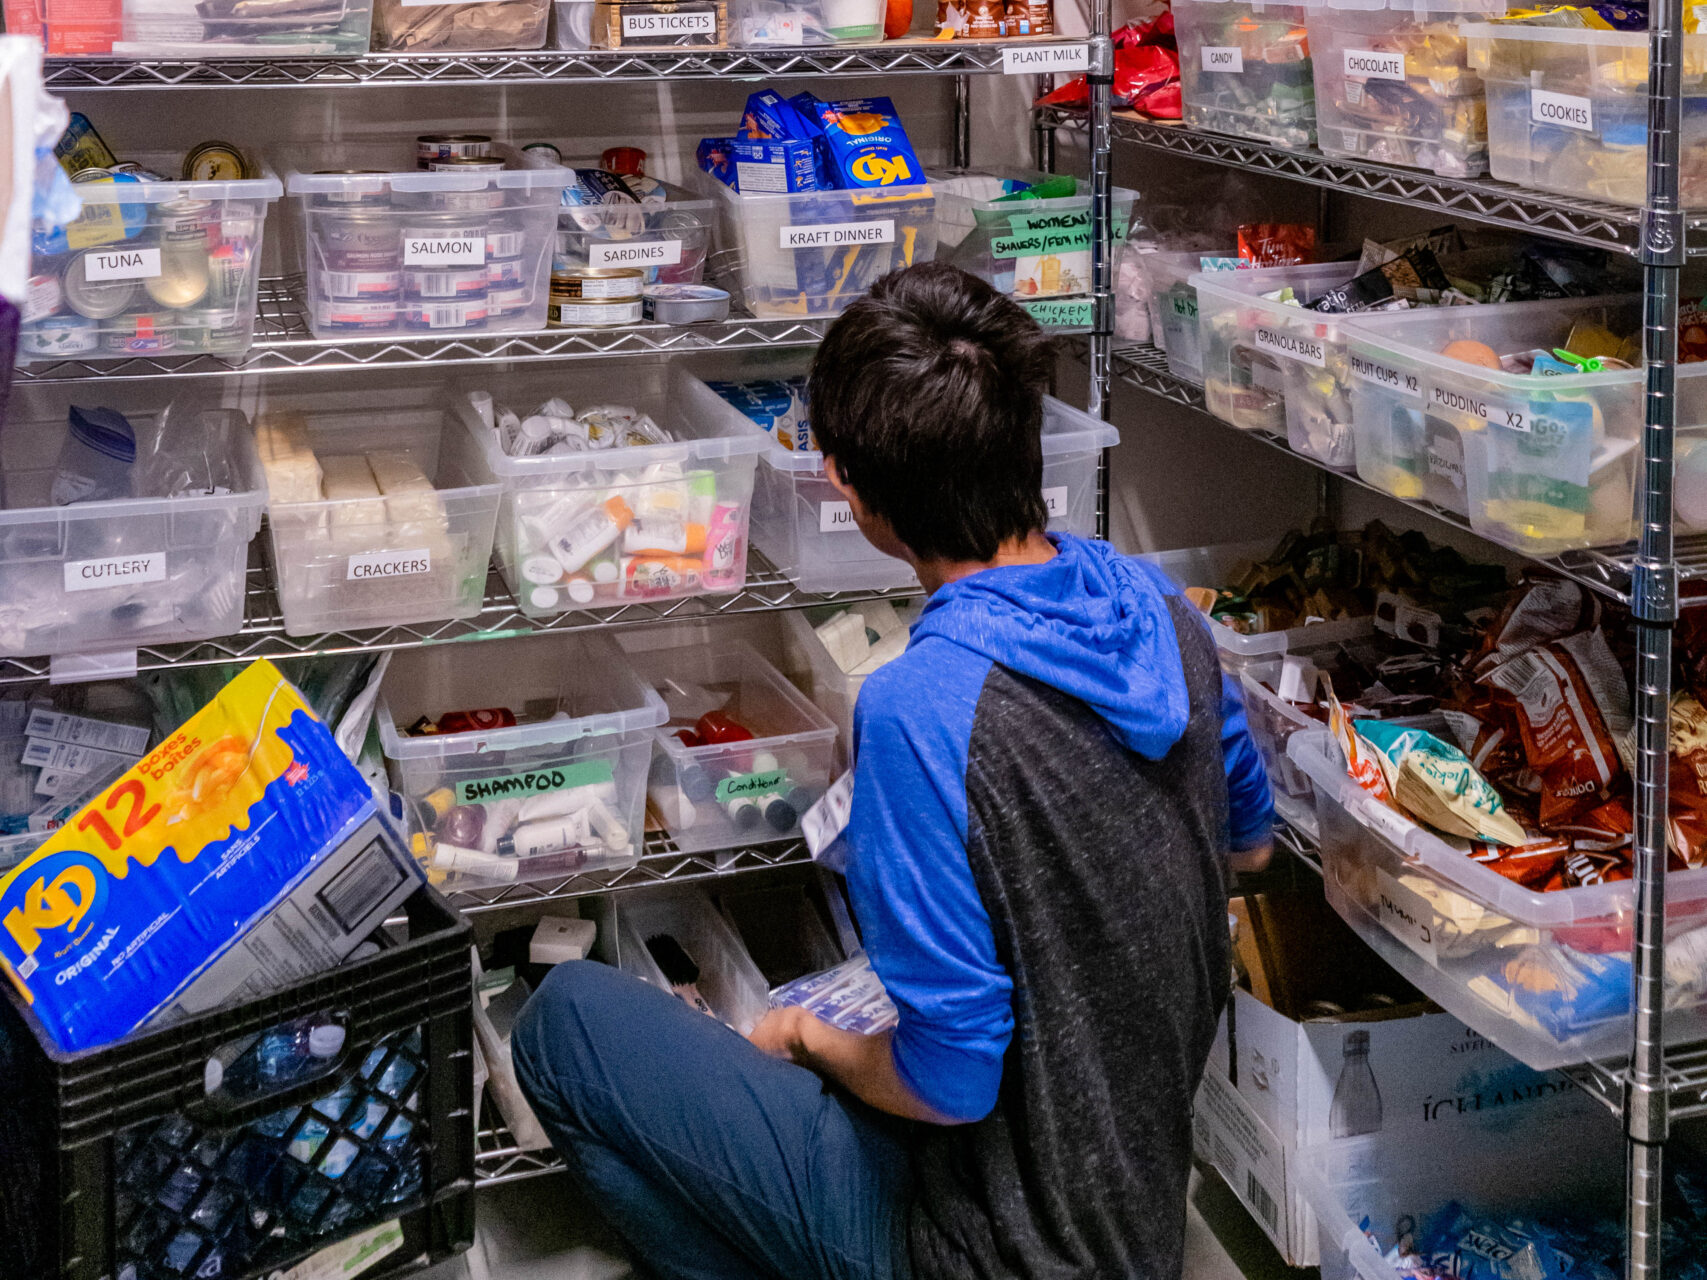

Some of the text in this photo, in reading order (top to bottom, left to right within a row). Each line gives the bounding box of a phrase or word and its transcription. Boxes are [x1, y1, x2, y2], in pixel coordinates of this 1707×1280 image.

[628, 15, 710, 30] BUS TICKETS
[1011, 48, 1083, 65] PLANT MILK
[1210, 50, 1234, 66] CANDY
[1347, 54, 1400, 77] CHOCOLATE
[1539, 100, 1589, 125] COOKIES
[846, 136, 892, 147] ORIGINAL
[851, 152, 912, 187] KD
[789, 227, 884, 246] KRAFT DINNER
[1258, 237, 1284, 255] Tim
[410, 241, 473, 256] SALMON
[603, 246, 665, 263] SARDINES
[97, 253, 144, 270] TUNA
[1030, 304, 1089, 317] CHICKEN
[1257, 328, 1323, 361] GRANOLA BARS
[1351, 356, 1419, 393] FRUIT CUPS X2
[1435, 387, 1524, 430] PUDDING X2
[81, 559, 151, 580] CUTLERY
[352, 558, 429, 579] CRACKERS
[137, 732, 188, 777] boxes
[150, 735, 203, 782] boîtes
[465, 770, 566, 801] SHAMPOO
[77, 778, 163, 852] 12
[216, 835, 261, 880] ARTIFICIELS
[220, 838, 243, 860] SANS
[3, 864, 98, 956] KD
[111, 912, 170, 966] NO ARTIFICIAL
[54, 924, 121, 987] ORIGINAL
